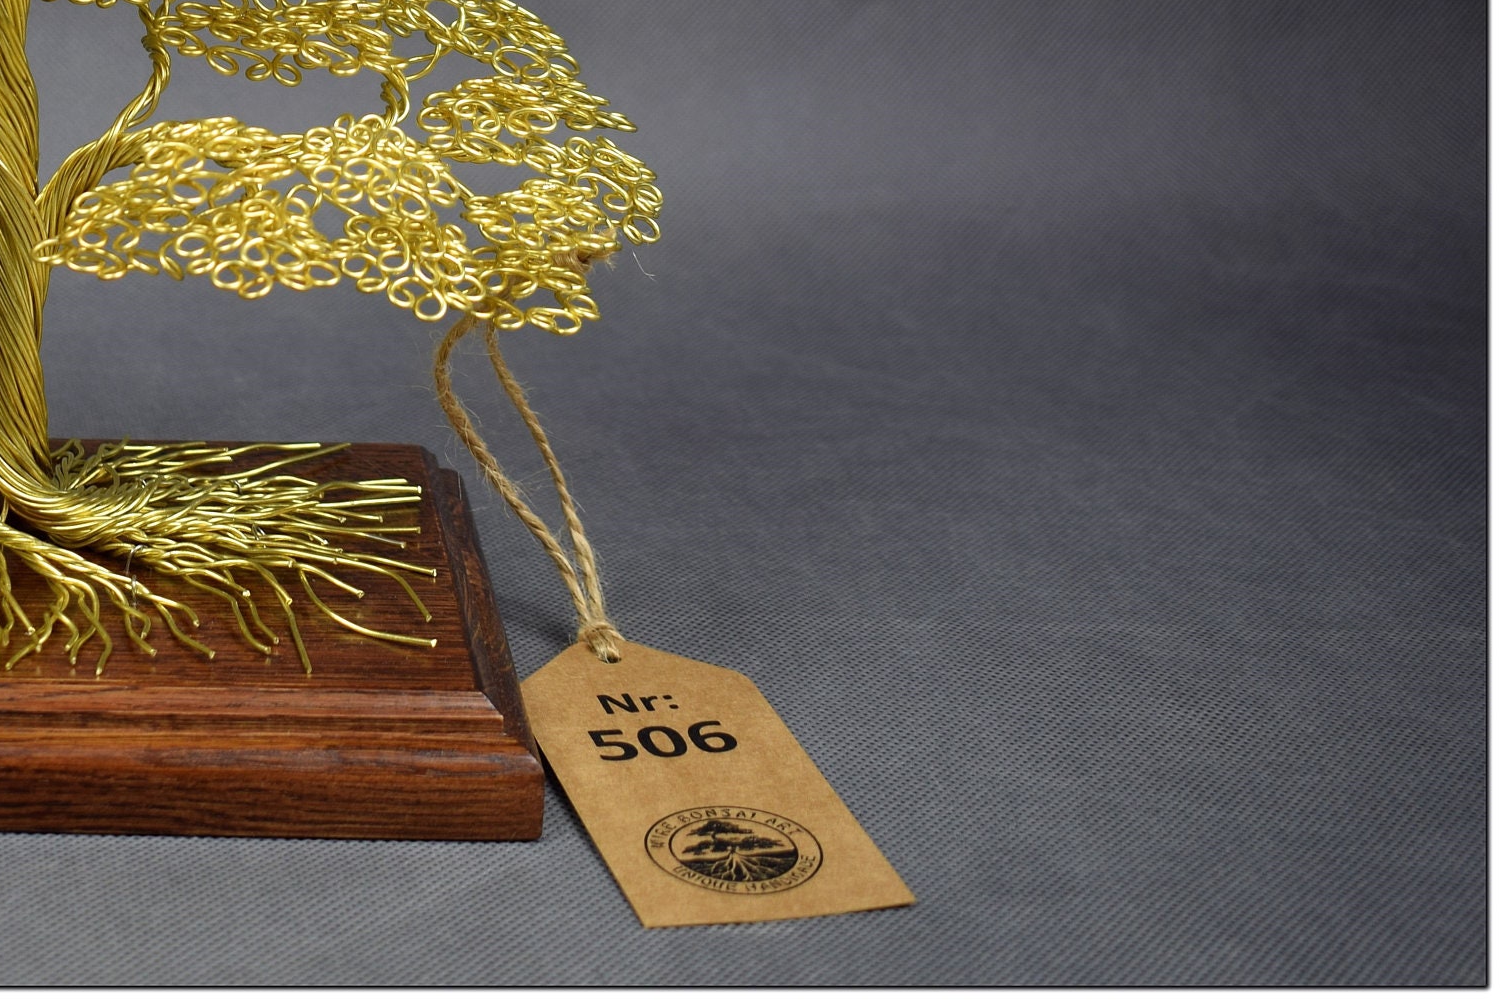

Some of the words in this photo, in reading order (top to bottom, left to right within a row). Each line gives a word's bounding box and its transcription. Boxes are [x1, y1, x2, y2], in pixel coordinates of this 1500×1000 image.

[596, 692, 679, 715] Nr:
[587, 719, 738, 762] 506
[677, 807, 757, 824] BONSAI
[764, 817, 805, 836] ART
[672, 865, 739, 892] UNIQUE
